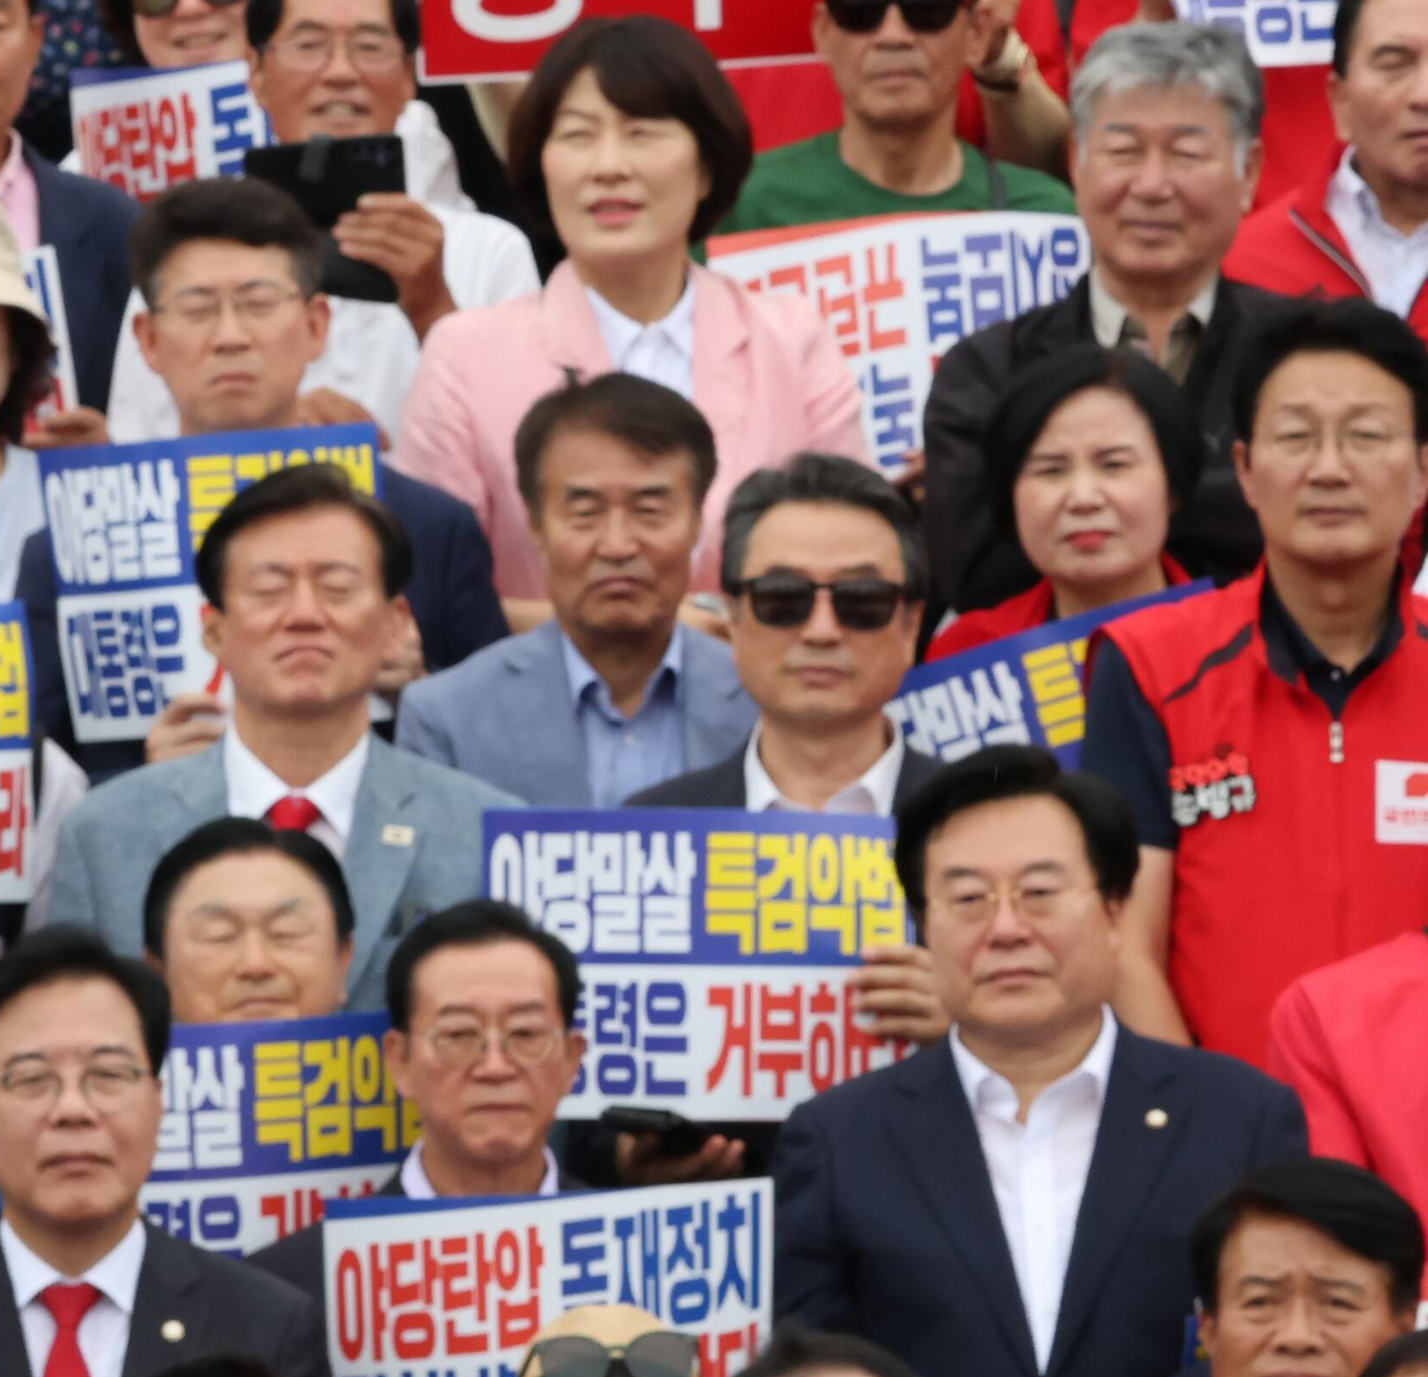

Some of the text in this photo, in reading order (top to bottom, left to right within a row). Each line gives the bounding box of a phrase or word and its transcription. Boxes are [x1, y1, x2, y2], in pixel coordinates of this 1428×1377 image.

[211, 84, 272, 178] 독
[47, 458, 181, 585] 야당말살
[67, 605, 185, 721] 대통령은
[488, 829, 912, 958] 야당말살 특검악법
[335, 1190, 763, 1362] 야당탄압 독재정치
